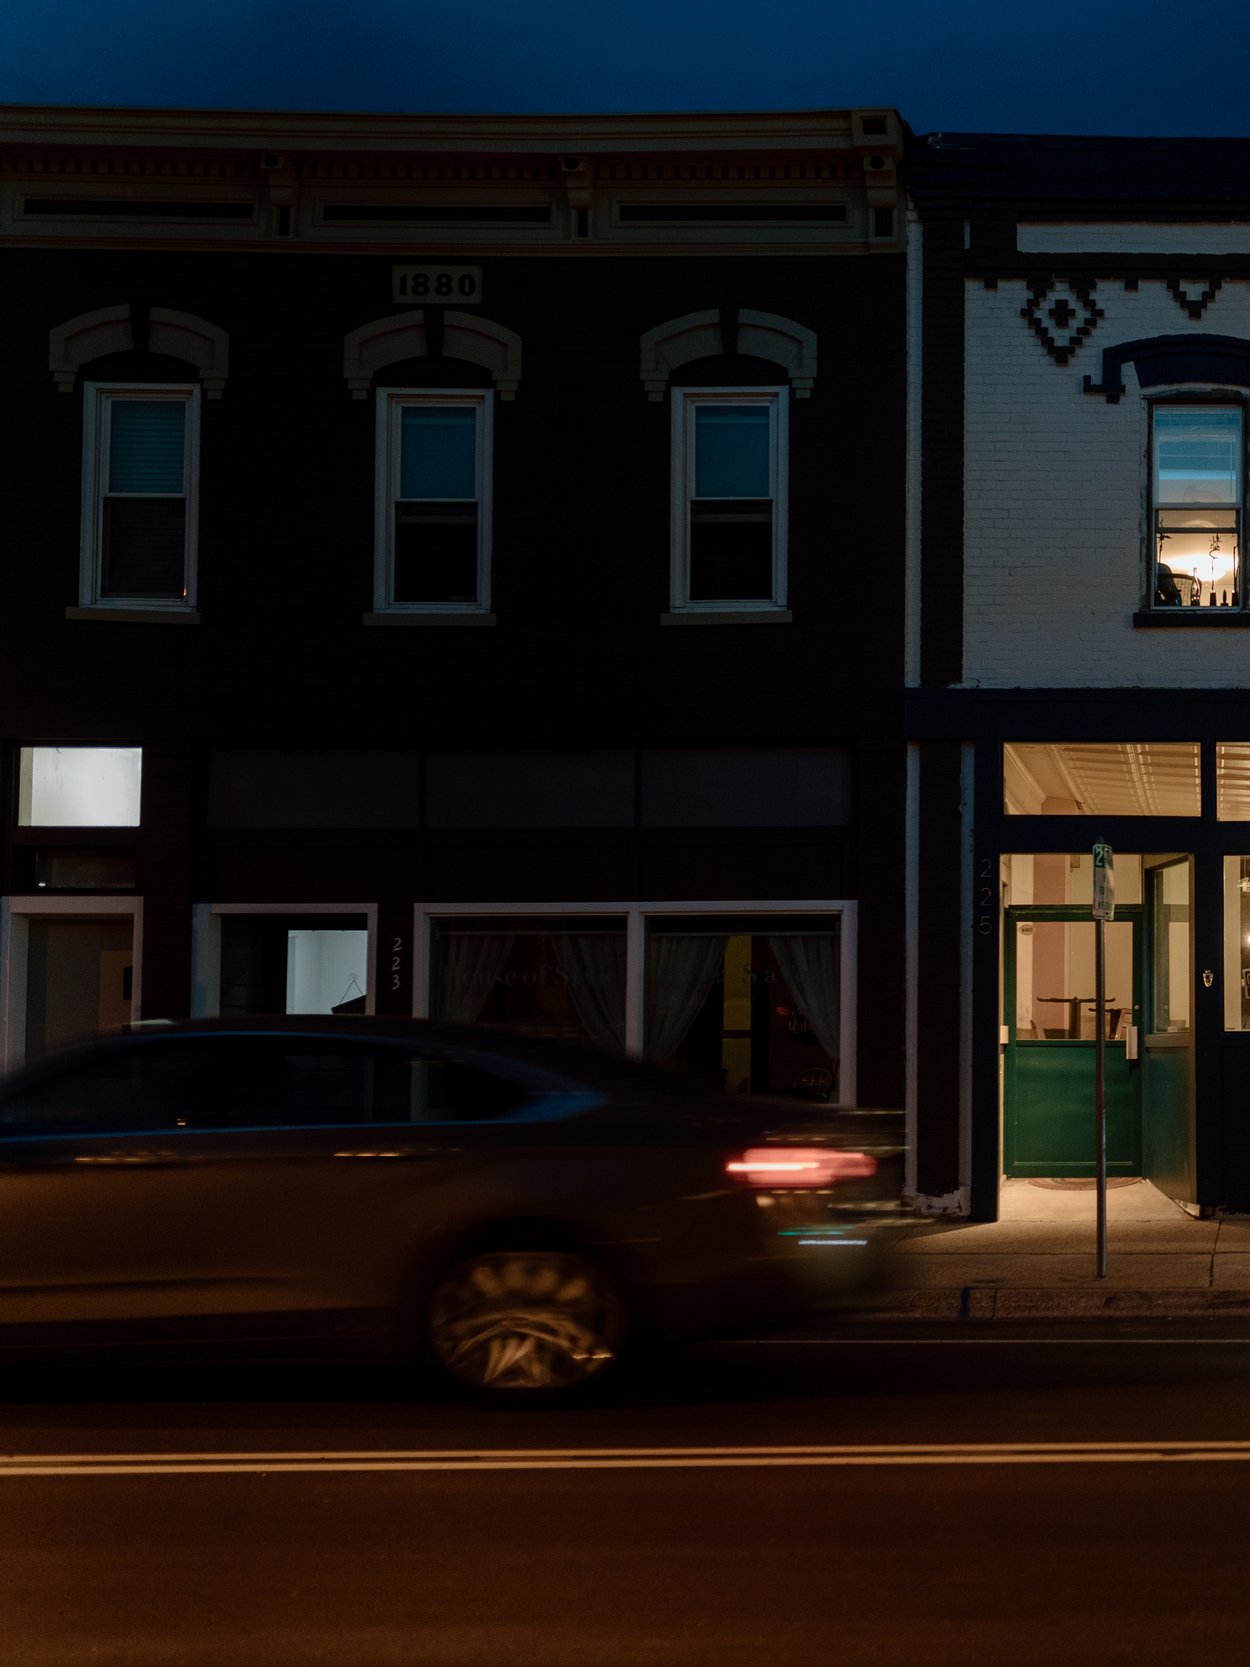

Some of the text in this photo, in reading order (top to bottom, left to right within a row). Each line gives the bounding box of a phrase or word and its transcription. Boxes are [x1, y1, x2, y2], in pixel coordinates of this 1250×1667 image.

[400, 273, 475, 296] 1880
[979, 858, 993, 935] 225
[392, 937, 402, 990] 223
